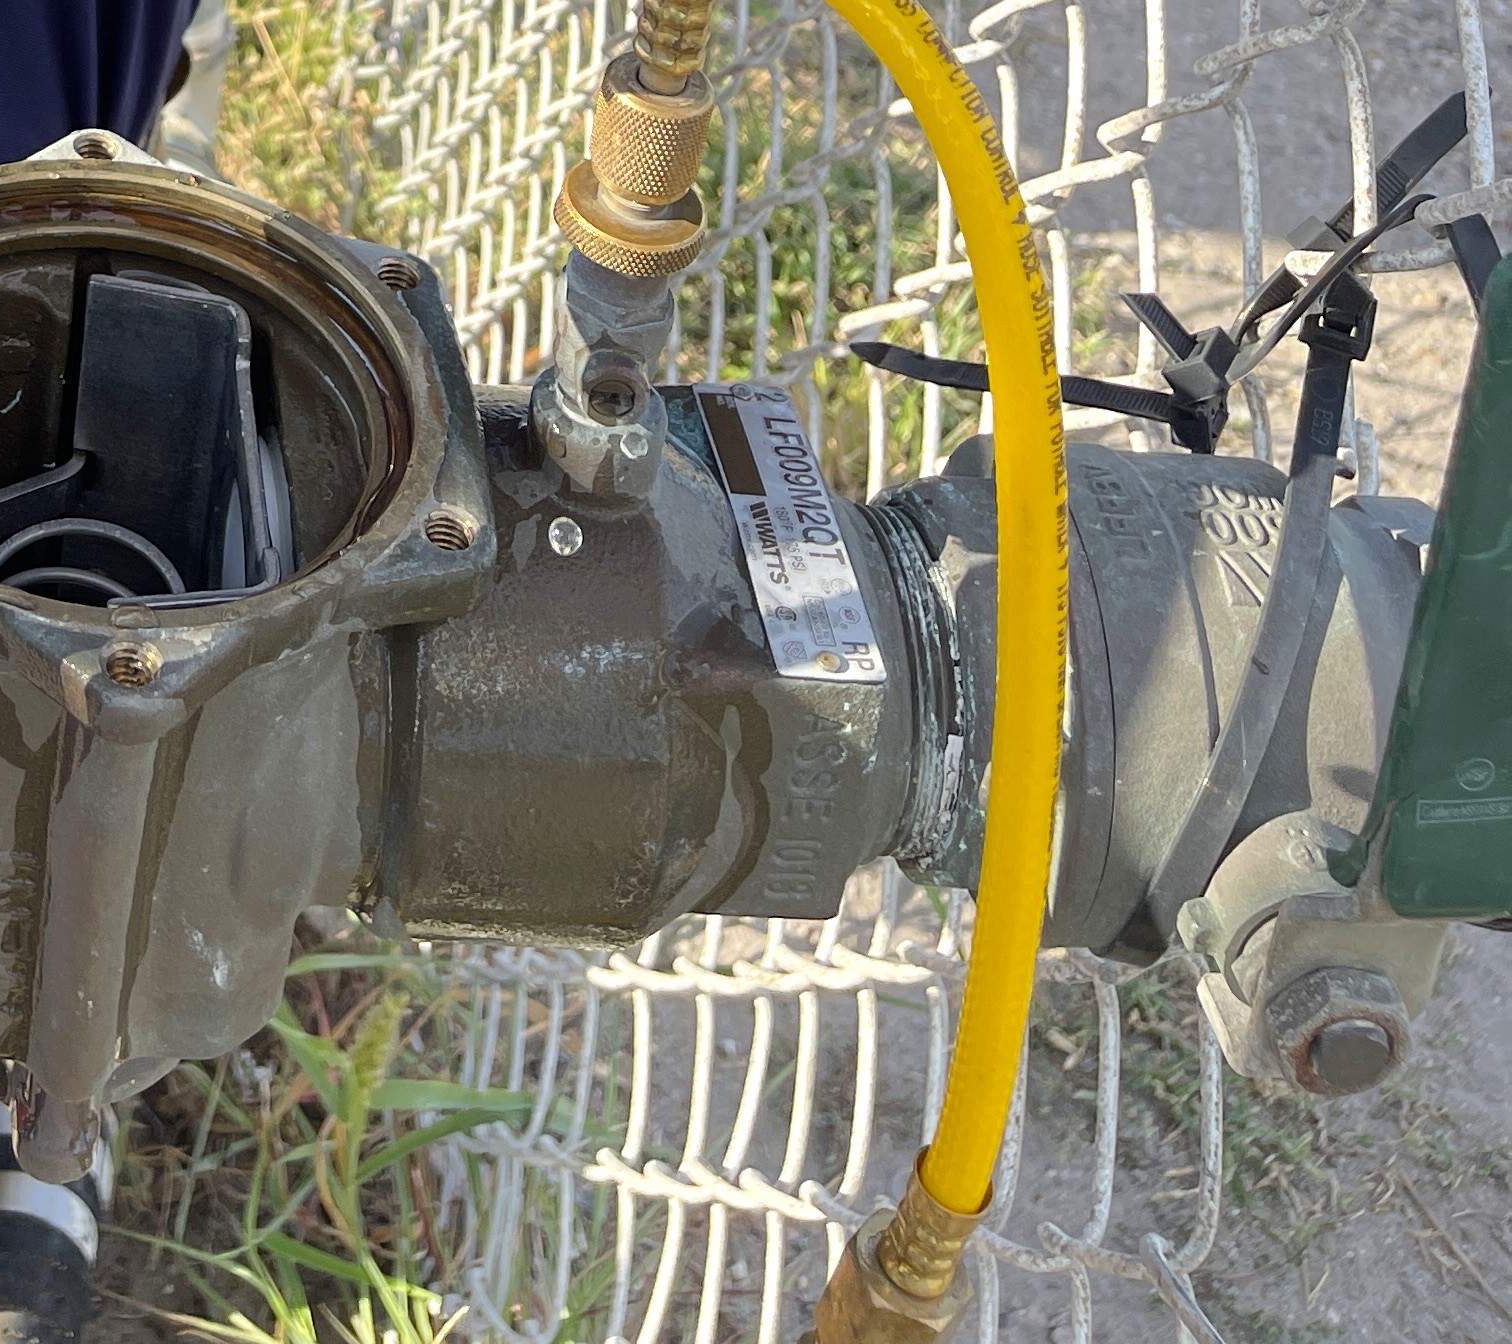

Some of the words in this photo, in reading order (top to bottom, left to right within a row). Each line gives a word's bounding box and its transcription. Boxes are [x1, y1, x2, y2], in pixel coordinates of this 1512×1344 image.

[764, 416, 846, 566] LF009M2QT
[754, 517, 789, 585] WATTS
[842, 640, 875, 671] RP
[781, 712, 849, 826] ASSE
